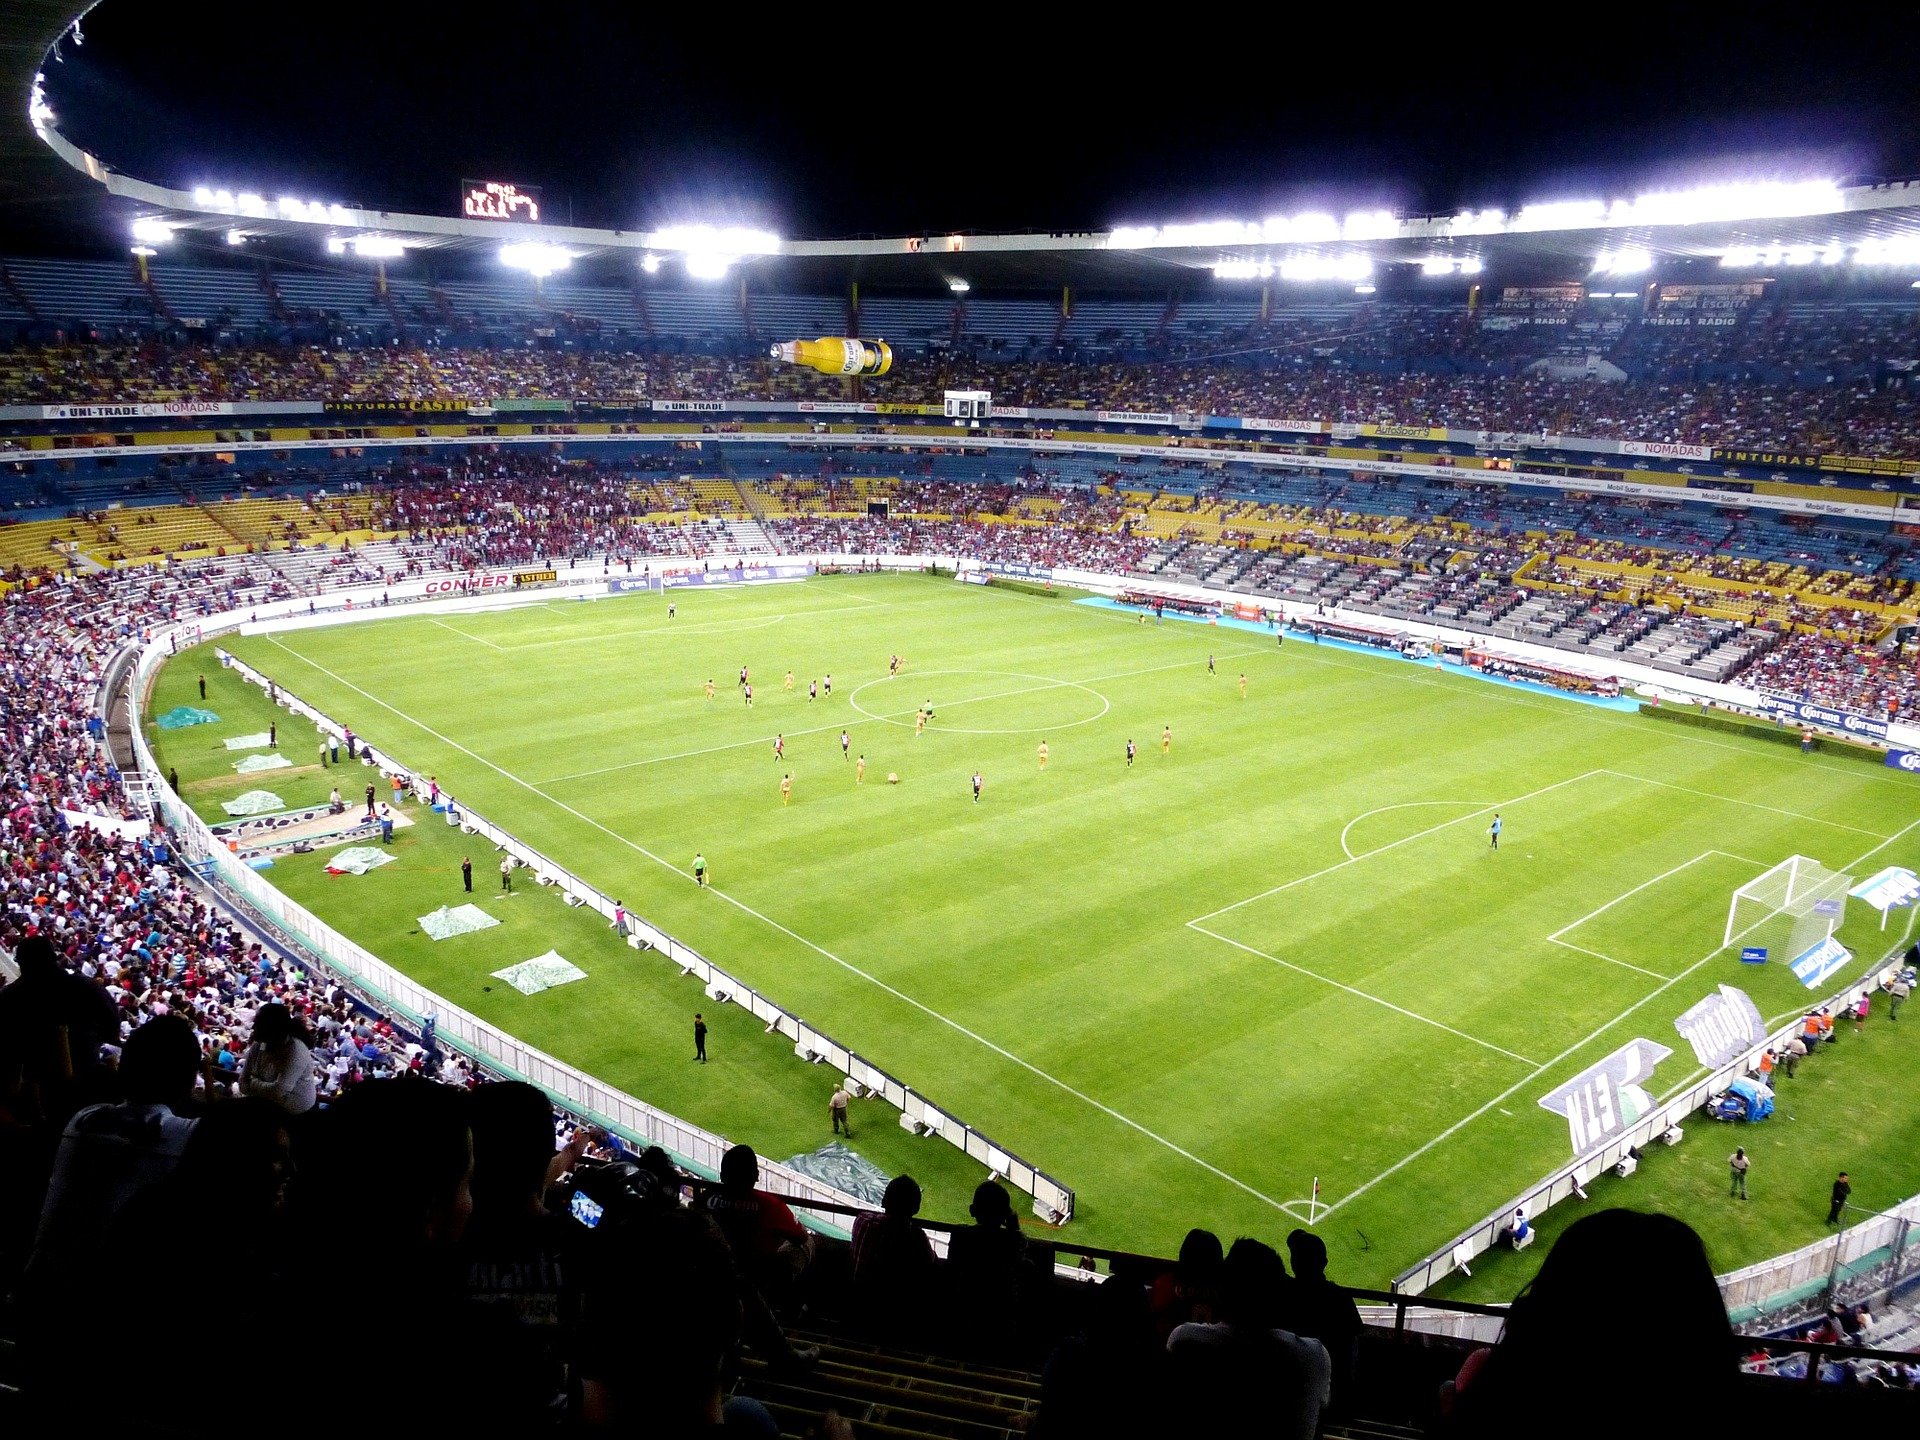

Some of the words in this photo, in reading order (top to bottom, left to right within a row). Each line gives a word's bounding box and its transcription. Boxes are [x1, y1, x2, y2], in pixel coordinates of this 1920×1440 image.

[1641, 318, 1691, 326] PRENSA
[1697, 318, 1736, 326] RADIO
[70, 406, 139, 417] UNI-TRADE
[163, 403, 220, 413] NOMADAS
[991, 407, 1021, 416] MADAS
[1267, 420, 1311, 430] NOMADAS
[1644, 443, 1702, 457] NOMADAS
[1713, 450, 1816, 466] PINTURAS
[1535, 477, 1552, 485] Super
[1606, 483, 1624, 491] Mobil
[1625, 485, 1641, 493] Super
[1701, 492, 1720, 501] Mobil
[1721, 495, 1739, 503] Super
[1805, 502, 1825, 511] Mobil
[1826, 505, 1846, 514] Super
[1759, 695, 1796, 714] Corona
[1800, 704, 1840, 724] Corona
[1844, 715, 1887, 734] Corona
